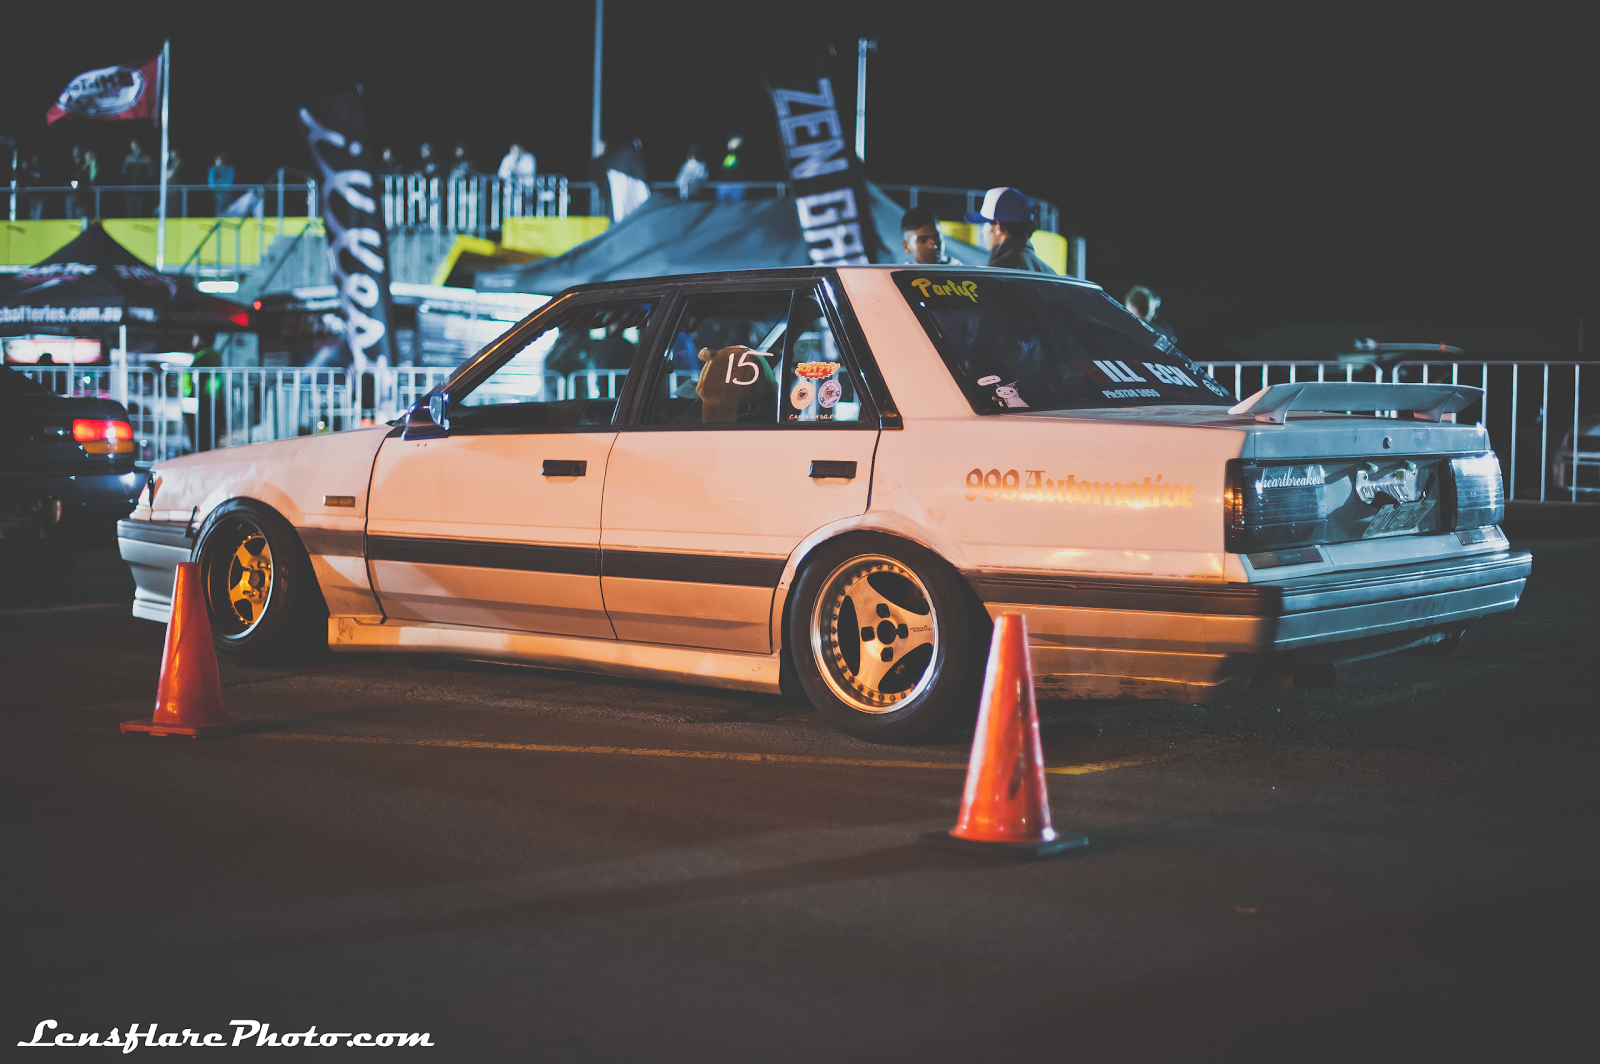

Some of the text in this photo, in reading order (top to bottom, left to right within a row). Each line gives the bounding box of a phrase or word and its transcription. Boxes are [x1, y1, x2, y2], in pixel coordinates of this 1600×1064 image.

[772, 78, 870, 266] ZEN GA
[911, 277, 979, 304] Party?
[725, 351, 774, 386] 15
[964, 467, 1197, 509] 999 Automotive
[1258, 464, 1322, 489] heartbreaker
